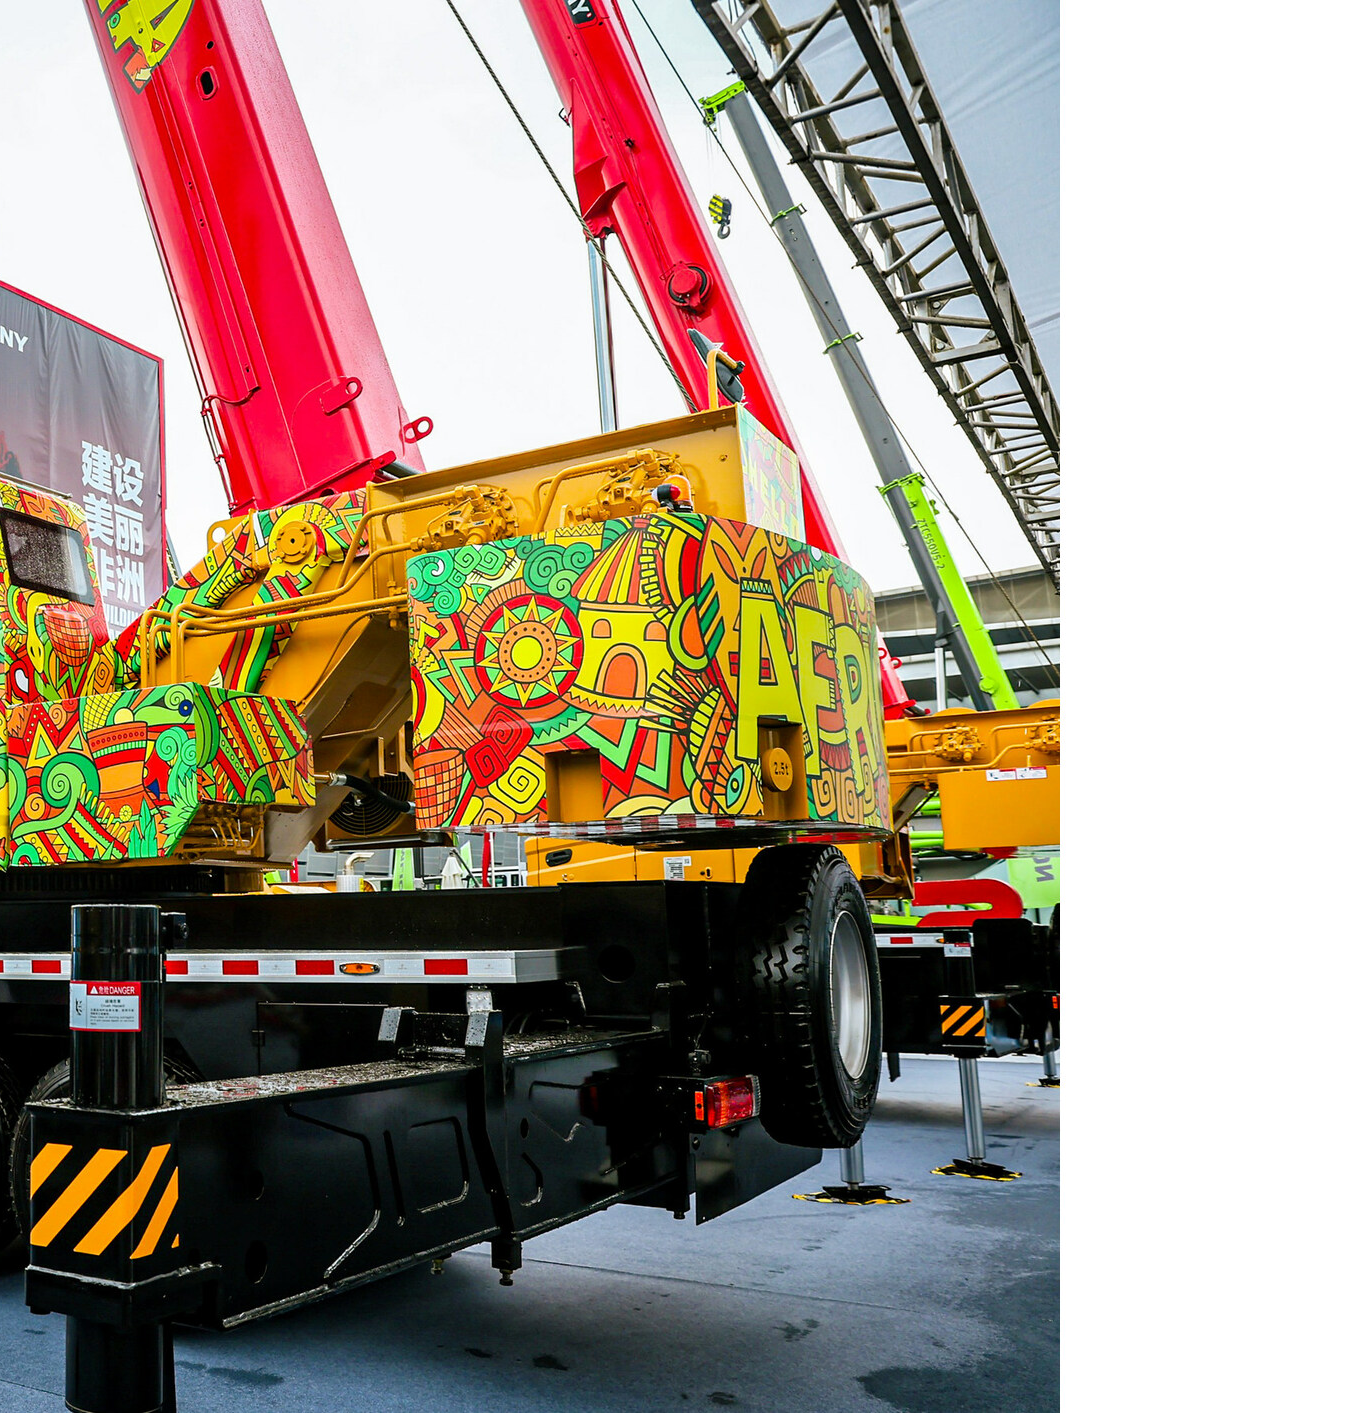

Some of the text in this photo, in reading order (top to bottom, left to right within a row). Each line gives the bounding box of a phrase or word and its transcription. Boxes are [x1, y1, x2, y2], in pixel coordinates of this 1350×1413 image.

[81, 440, 144, 507] 建设
[83, 493, 144, 557] 美丽
[774, 761, 789, 776] 2.5t
[110, 986, 135, 995] DANGER
